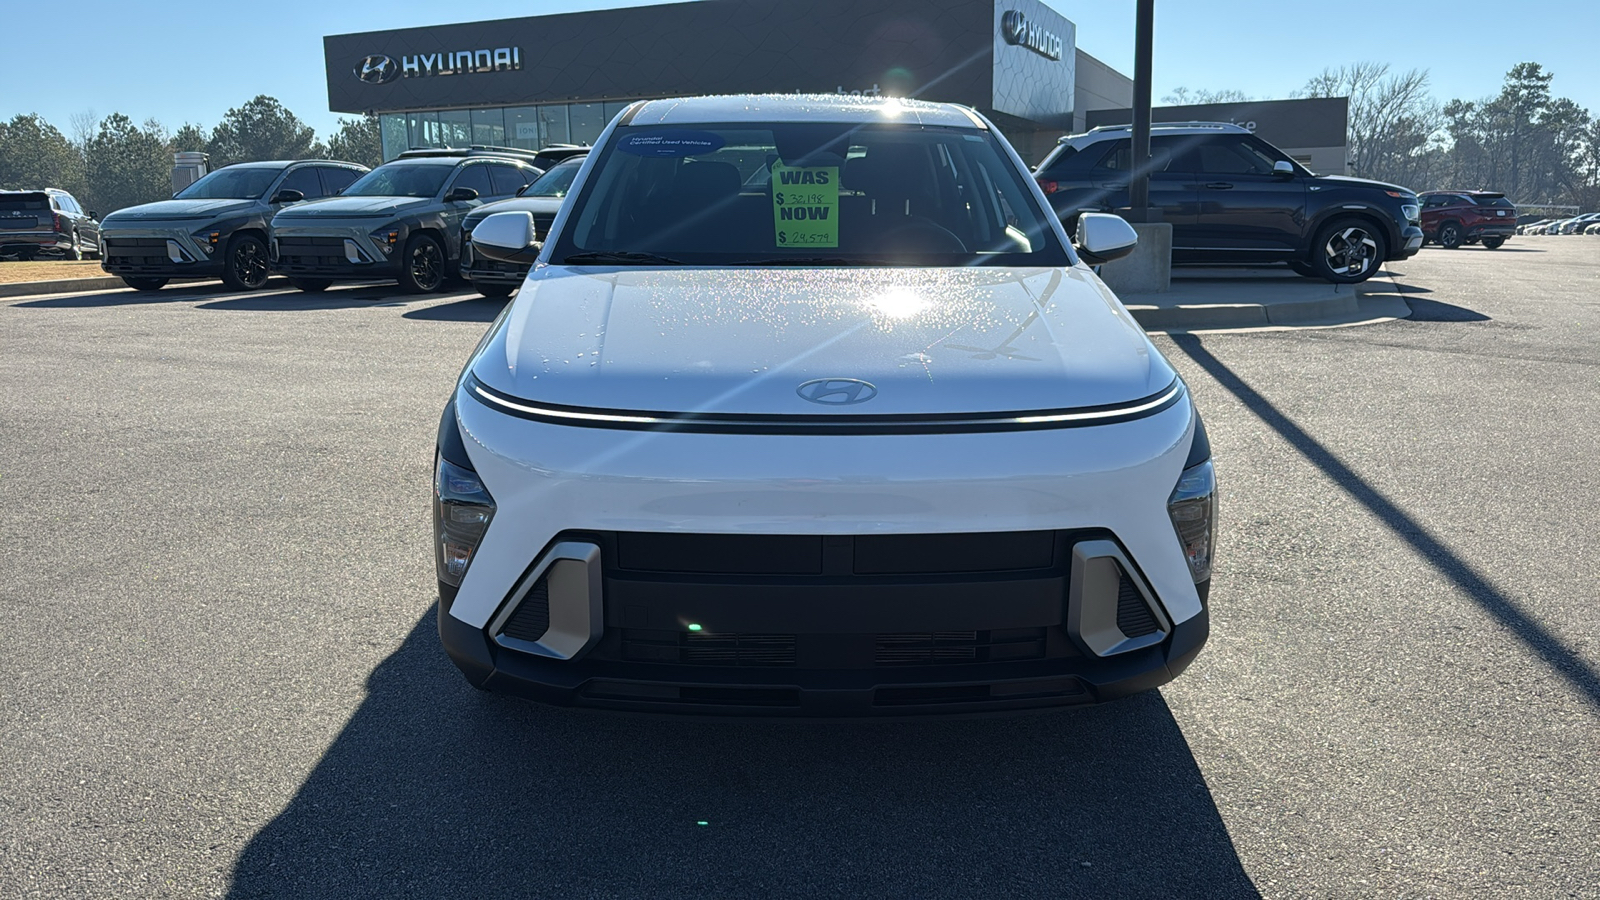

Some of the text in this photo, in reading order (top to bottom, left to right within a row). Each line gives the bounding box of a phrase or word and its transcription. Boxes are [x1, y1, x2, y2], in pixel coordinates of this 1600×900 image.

[1027, 20, 1063, 60] HYUNDAI
[402, 46, 519, 78] HYUNDAI
[519, 127, 538, 135] IONI
[779, 171, 829, 185] WAS
[780, 206, 830, 221] NOW
